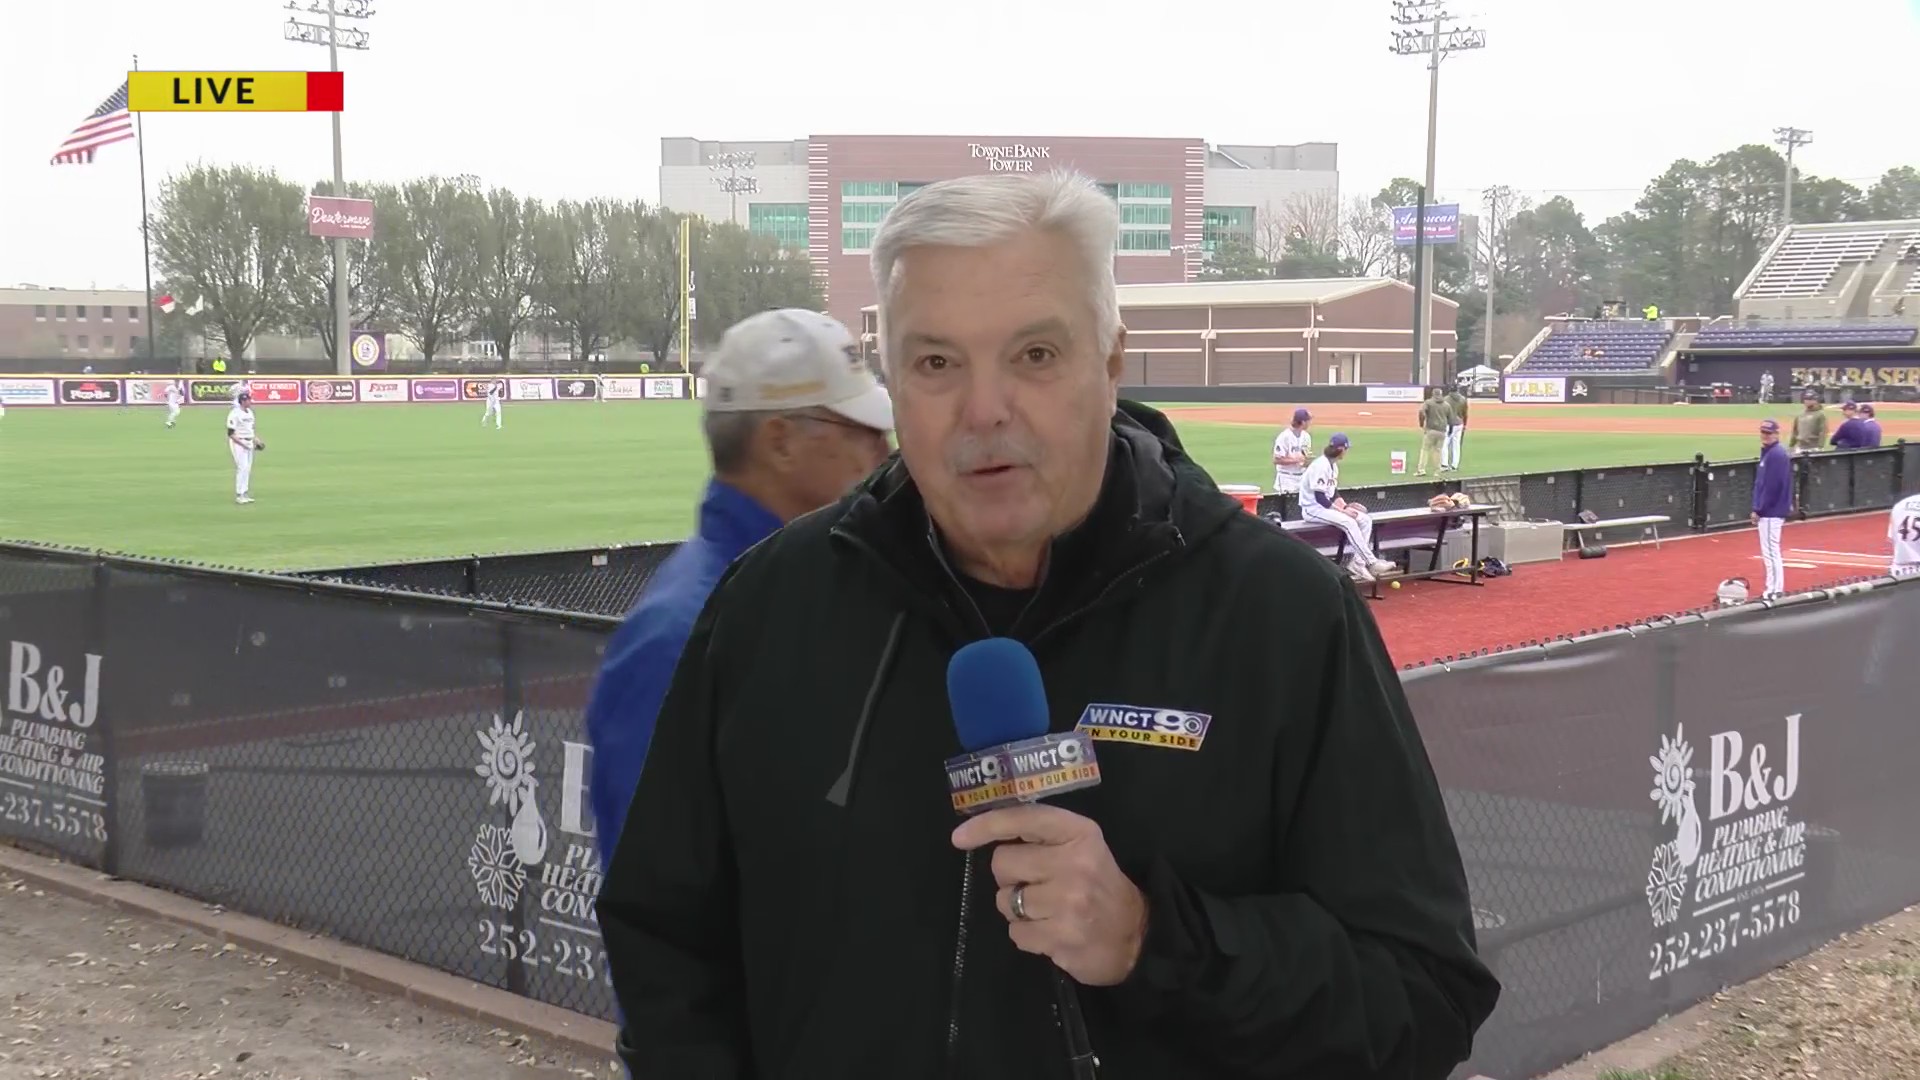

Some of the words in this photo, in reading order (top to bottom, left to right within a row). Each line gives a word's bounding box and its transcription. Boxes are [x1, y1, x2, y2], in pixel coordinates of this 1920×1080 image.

[1396, 212, 1457, 225] Amrican
[8, 640, 103, 728] B&J
[11, 718, 87, 750] PLUMBING
[1109, 729, 1151, 742] YOUR
[1160, 734, 1197, 748] SIDE
[76, 753, 104, 774] AIR
[1019, 781, 1034, 792] ON
[1039, 771, 1068, 788] YOUR
[1071, 766, 1096, 780] SIDE
[1709, 712, 1802, 821] B&J
[1696, 836, 1763, 878] HEATING
[1764, 832, 1777, 854] &
[1778, 821, 1806, 850] AIR
[1712, 805, 1789, 850] PLUMBING
[1695, 843, 1807, 903] CONDITIONING
[1649, 889, 1800, 981] 252-237-5578
